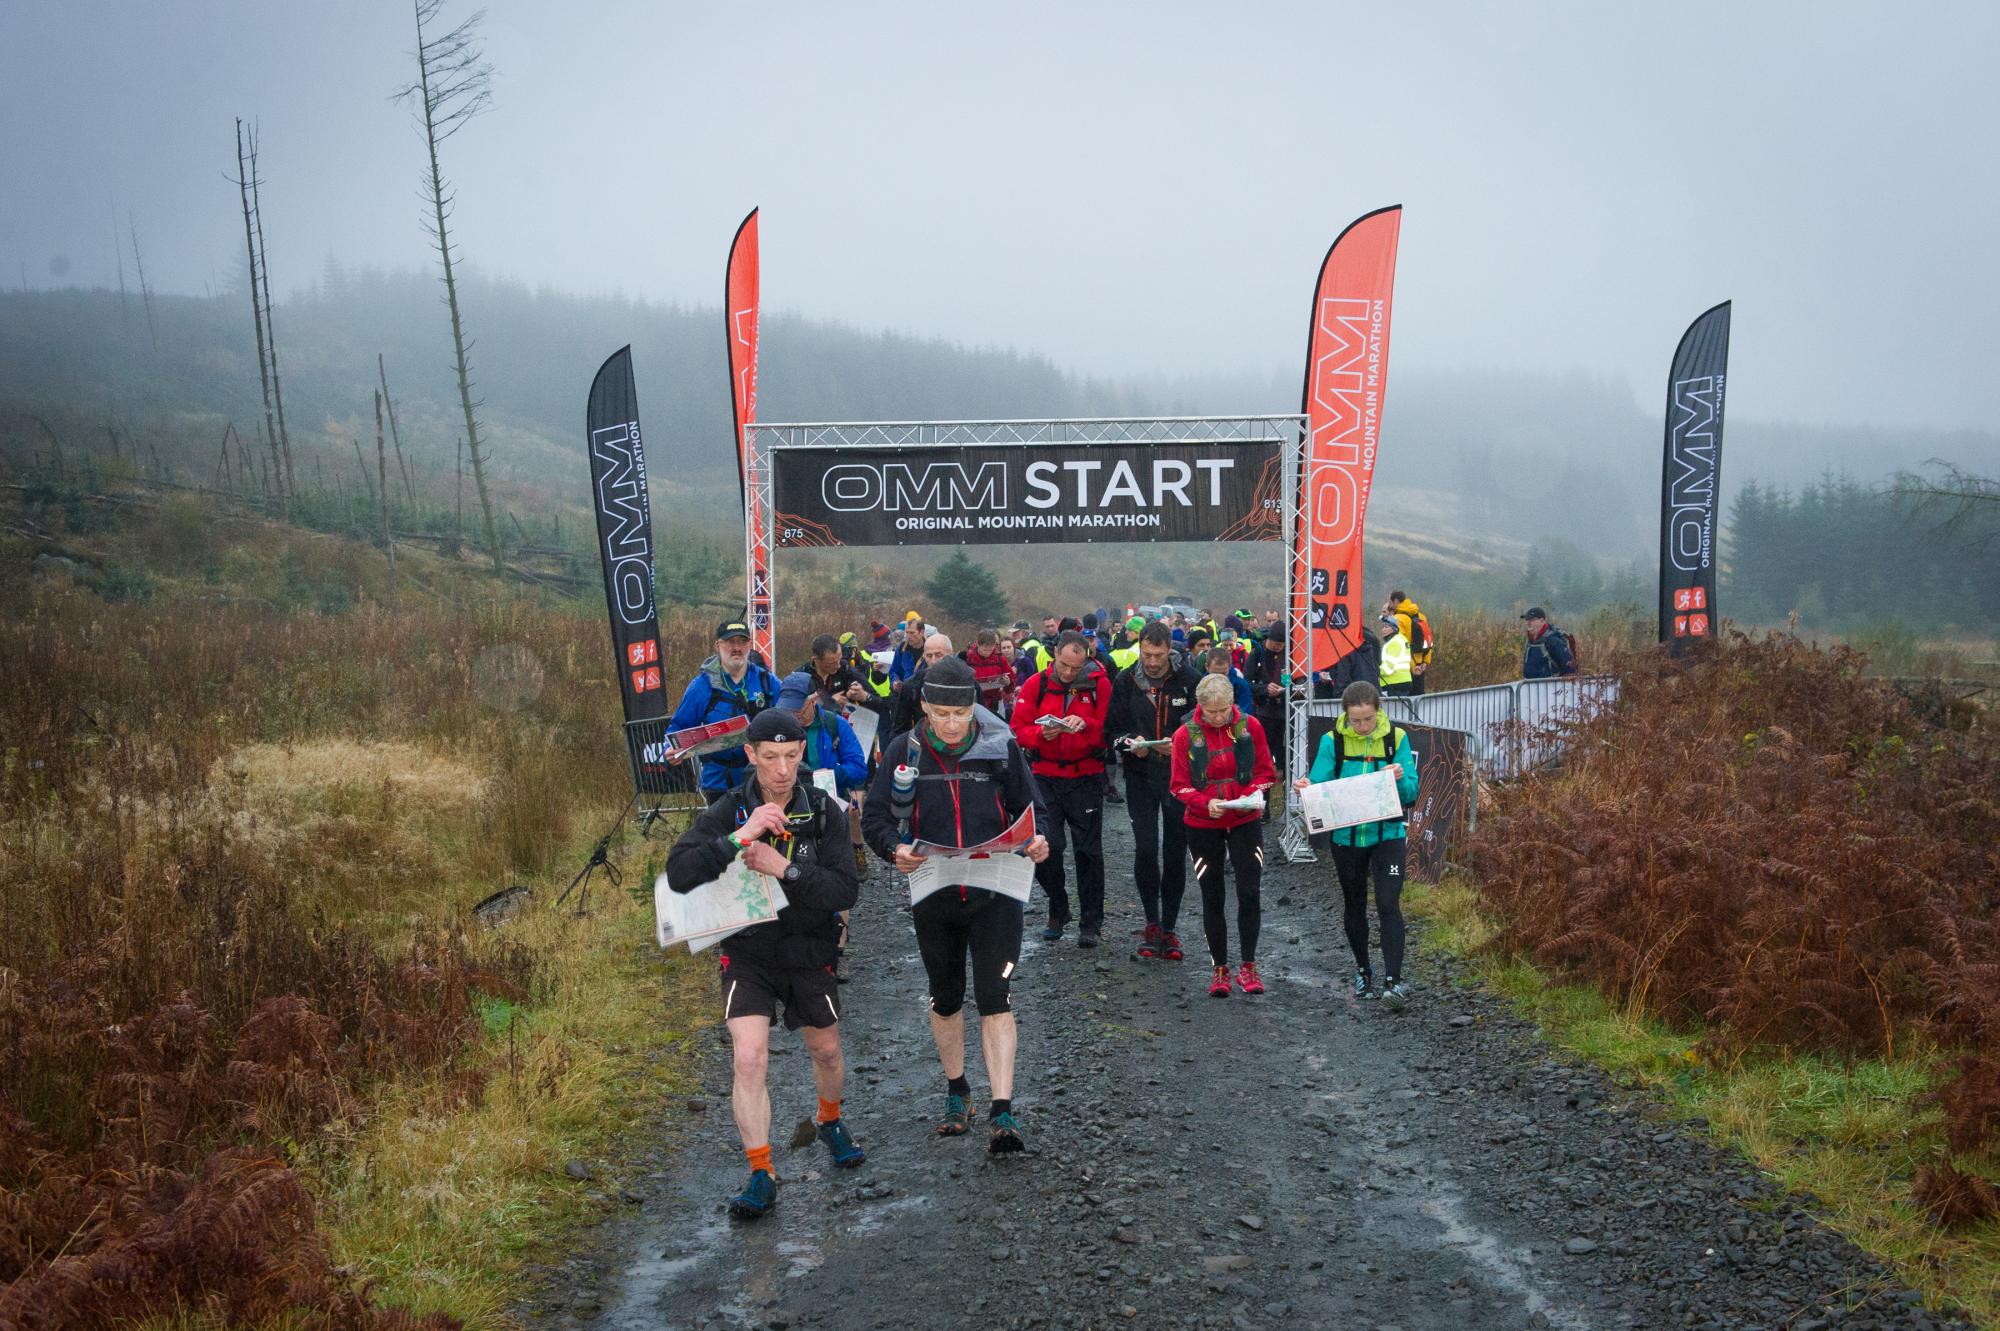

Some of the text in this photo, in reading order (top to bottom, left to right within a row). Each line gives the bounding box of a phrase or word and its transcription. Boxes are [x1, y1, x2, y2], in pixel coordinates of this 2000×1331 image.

[1367, 300, 1384, 386] MARATHON
[629, 421, 647, 492] MARATHON
[1311, 298, 1370, 545] OMM
[1363, 390, 1377, 471] MOUNTAIN
[822, 459, 1235, 512] OMM START
[1670, 376, 1713, 570] OMM
[593, 423, 648, 624] OMM
[784, 529, 803, 539] 675
[896, 514, 1160, 530] ORIGINAL MOUNTAIN MARATHON
[1701, 510, 1712, 568] ORIGINAL
